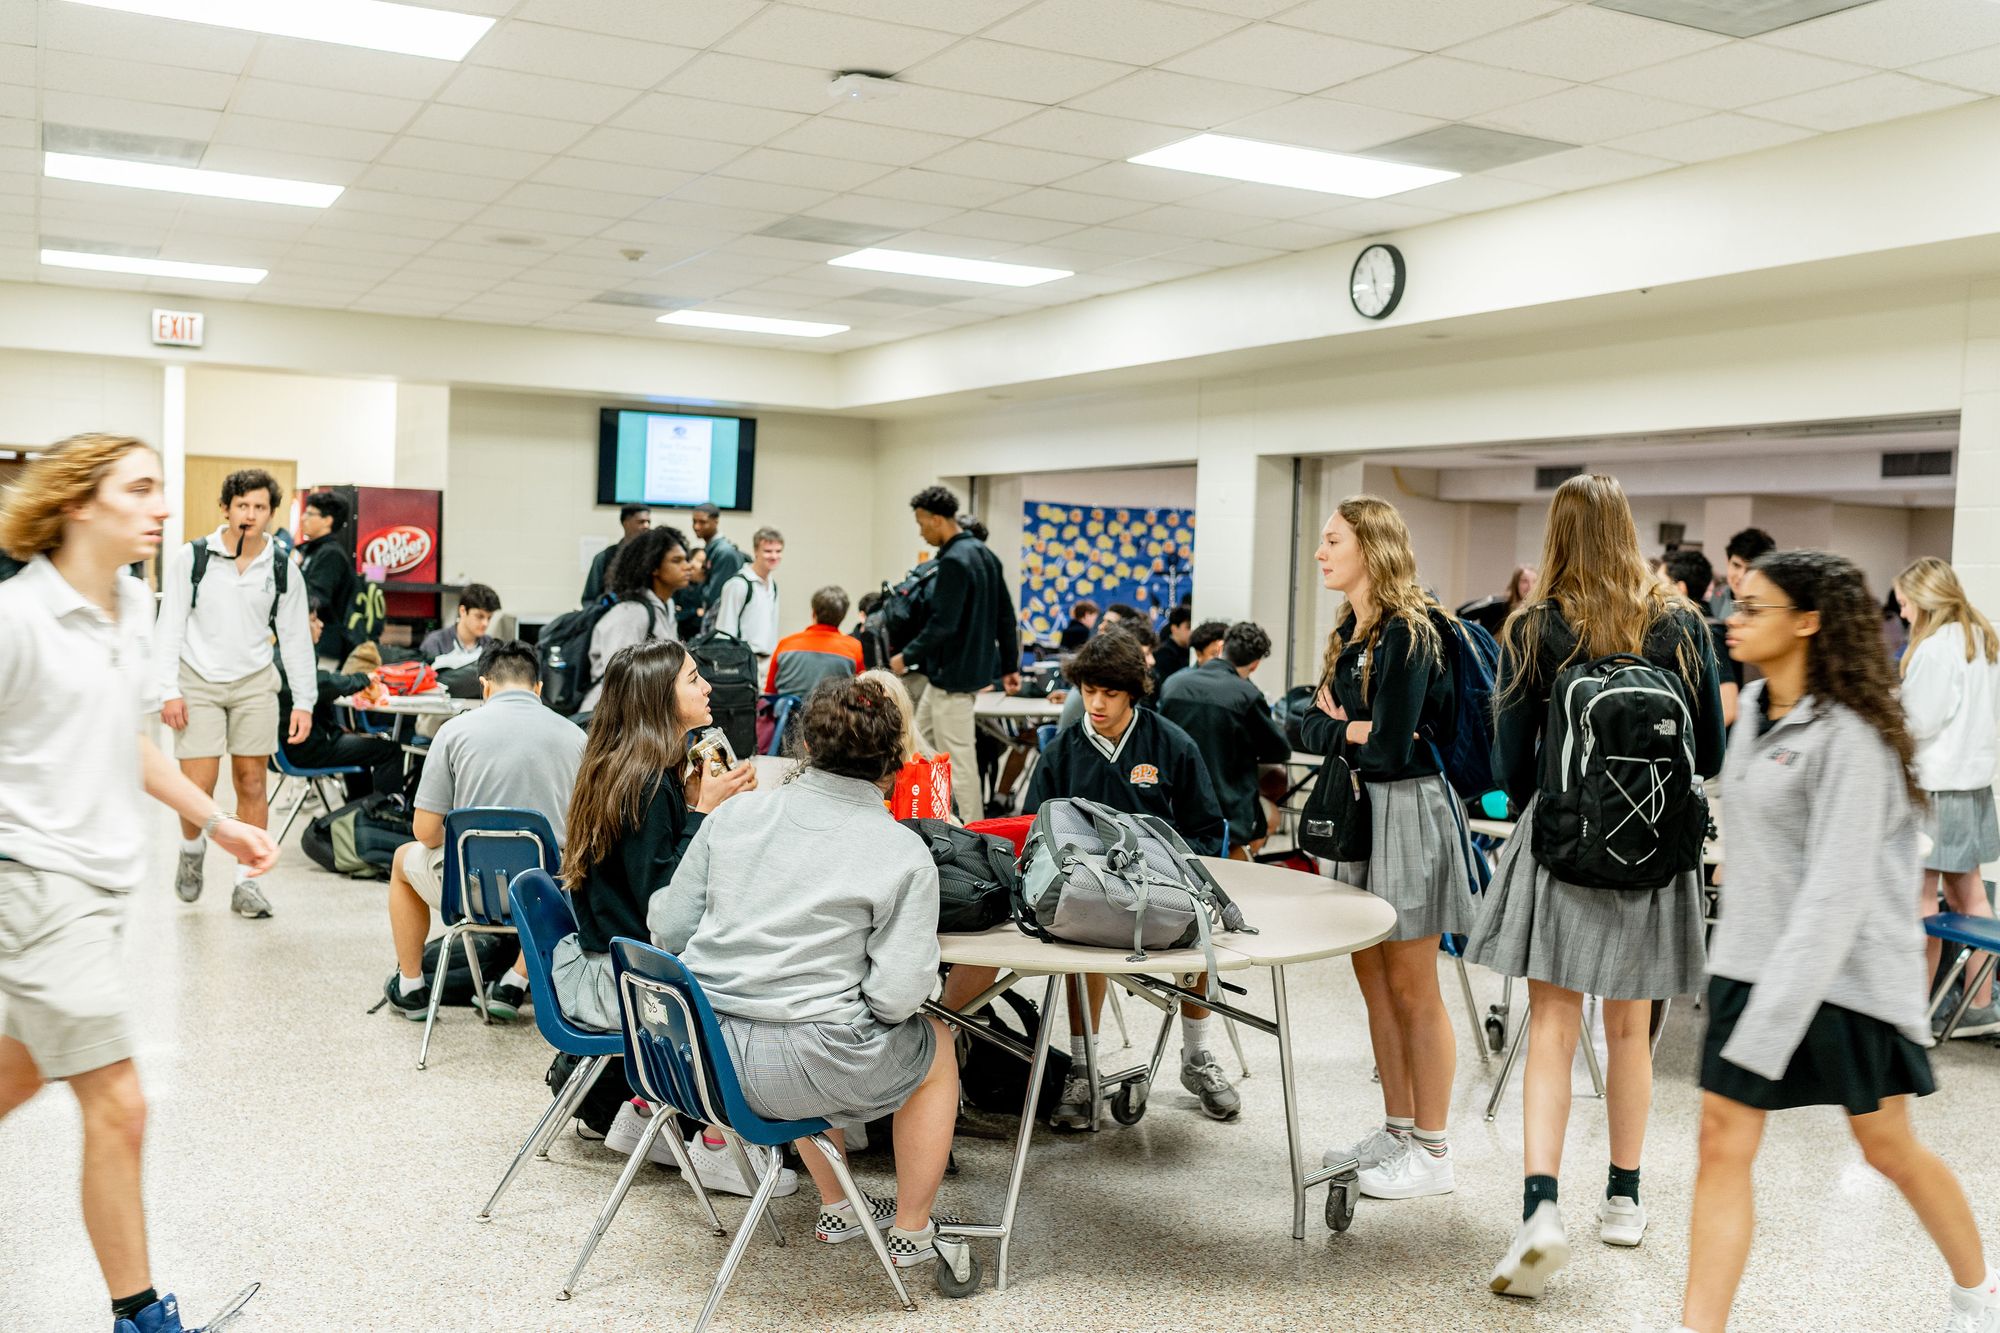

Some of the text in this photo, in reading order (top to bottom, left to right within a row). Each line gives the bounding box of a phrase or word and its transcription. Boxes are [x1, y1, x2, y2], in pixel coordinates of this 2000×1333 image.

[159, 315, 195, 340] EXIT
[387, 532, 410, 548] Dr
[373, 536, 424, 568] Pepper
[1131, 764, 1158, 780] SPX
